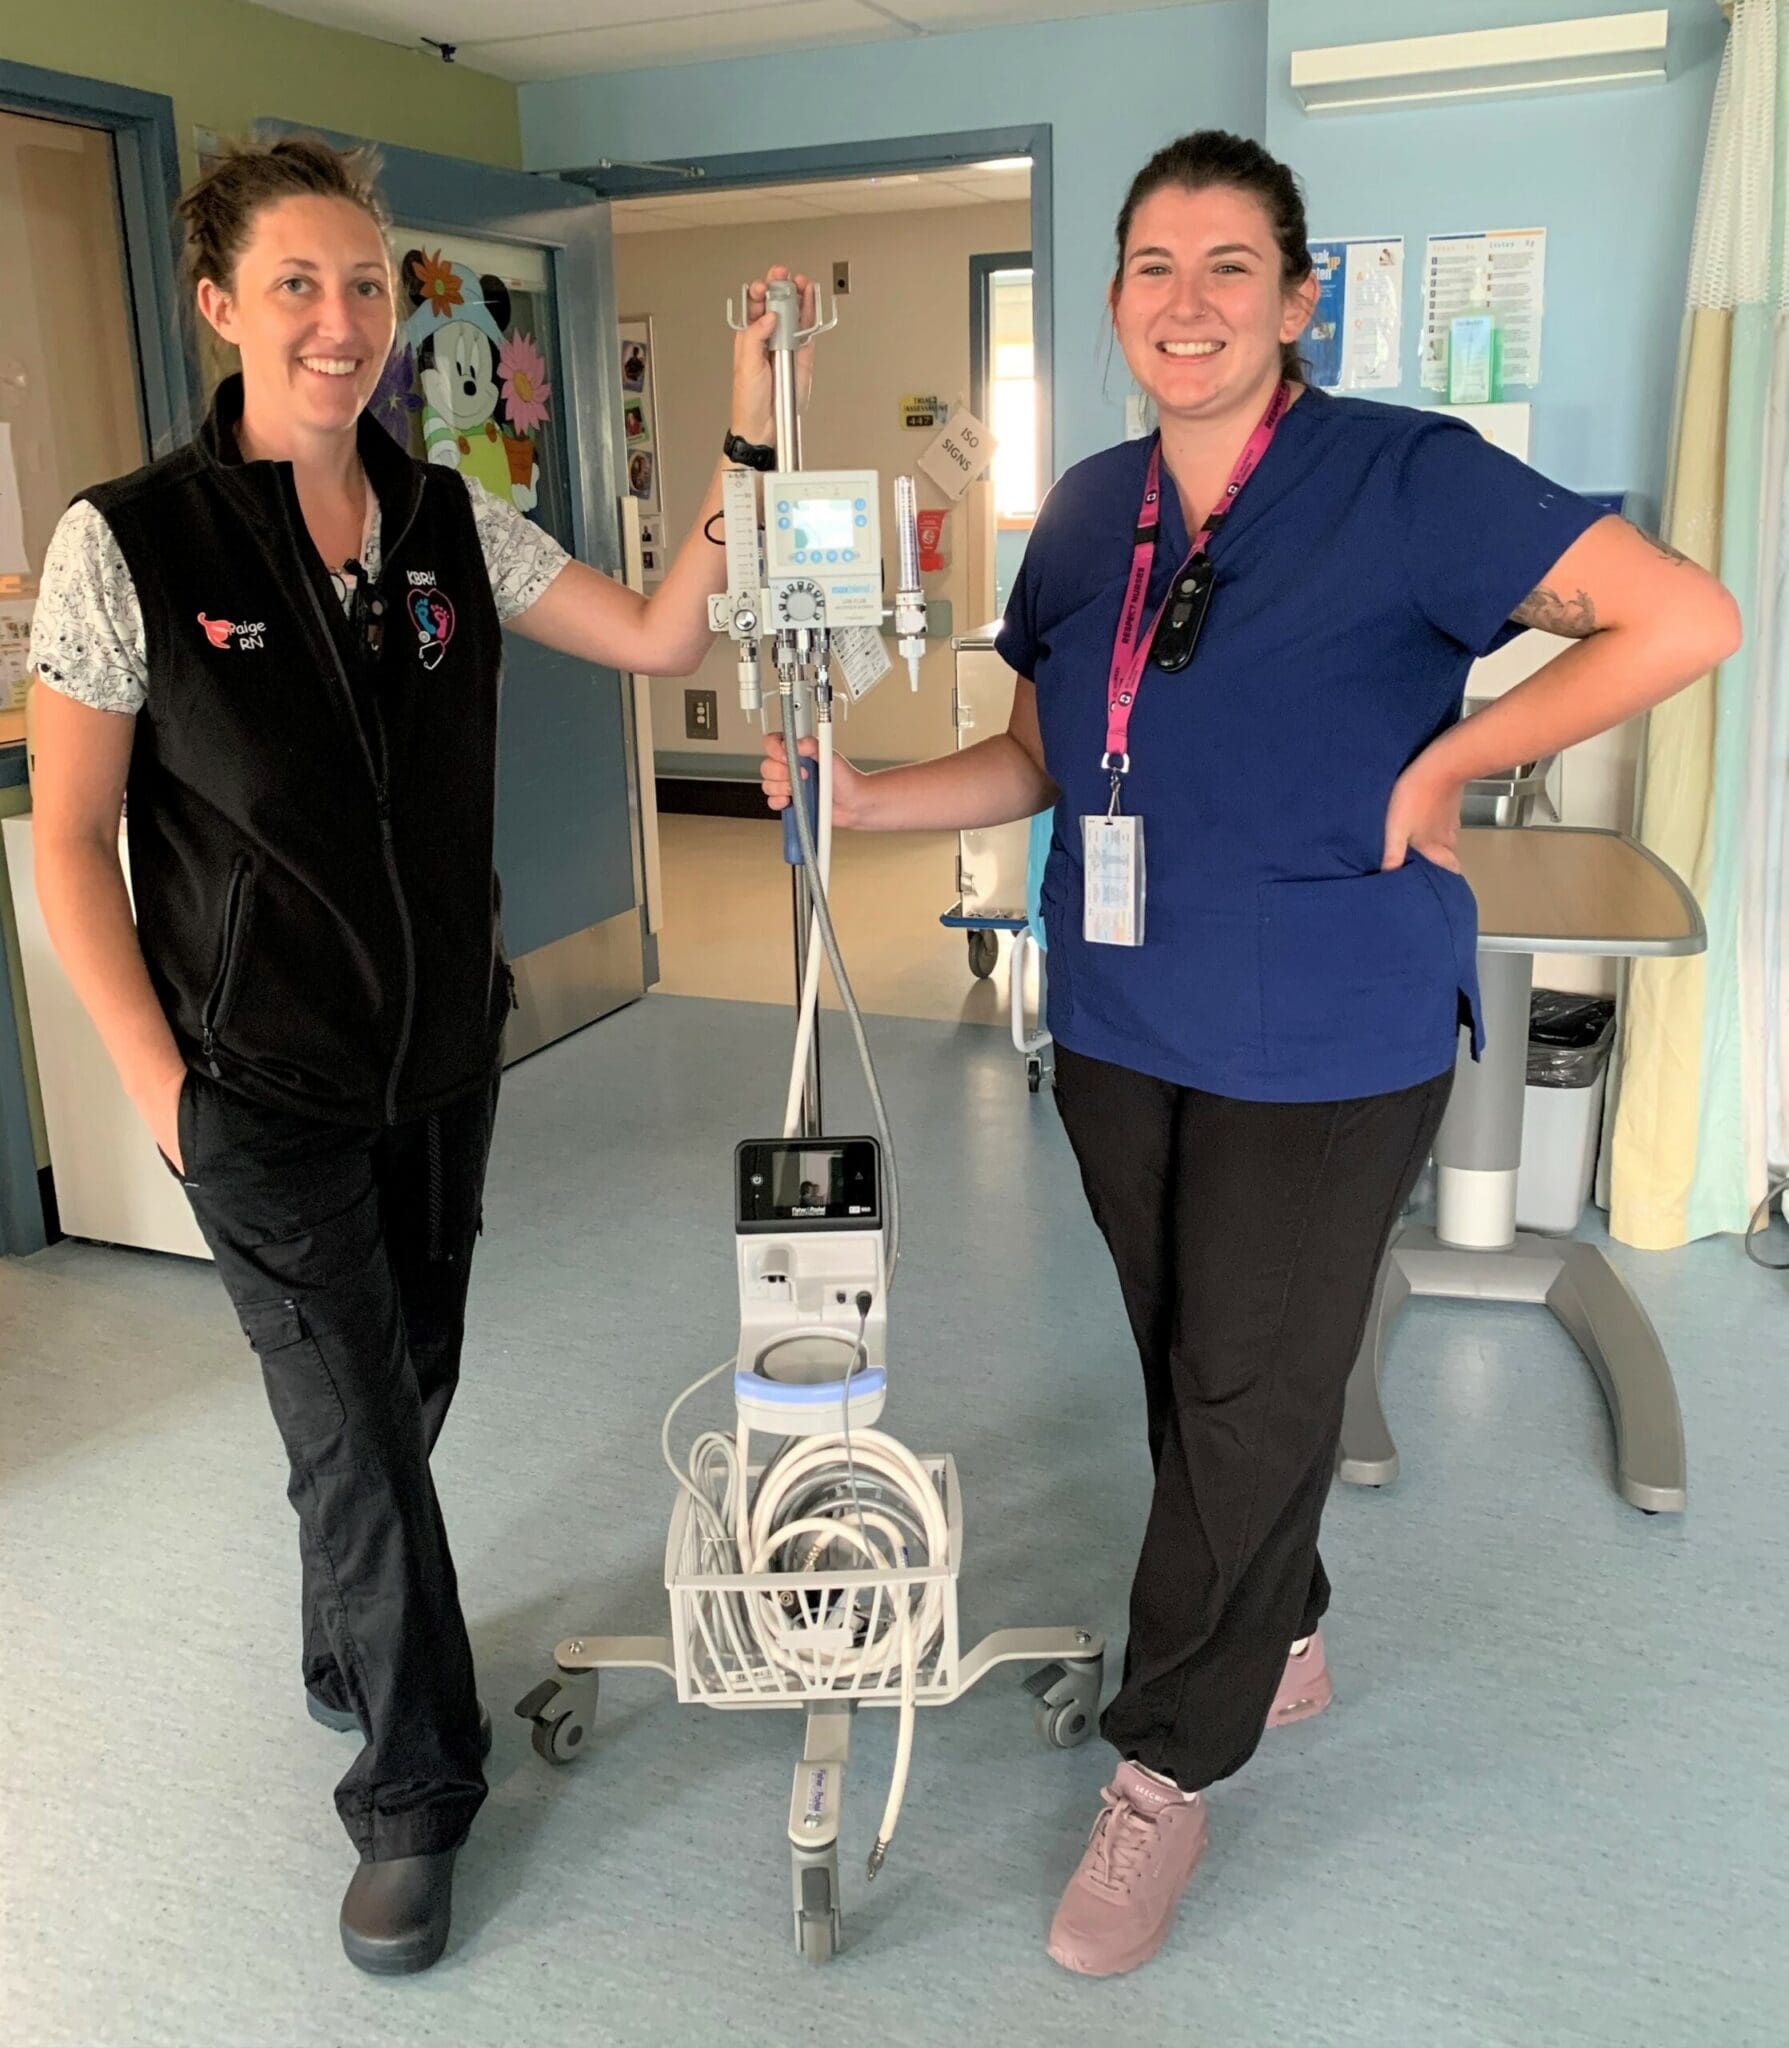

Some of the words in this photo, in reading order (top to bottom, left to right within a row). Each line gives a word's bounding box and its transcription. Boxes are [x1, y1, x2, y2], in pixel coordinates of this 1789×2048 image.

[960, 427, 980, 448] ISO
[941, 438, 972, 471] SIGNS
[406, 569, 437, 586] KBRH
[1122, 604, 1138, 645] RESPECT
[1132, 567, 1146, 604] NURSES
[239, 635, 265, 650] RN
